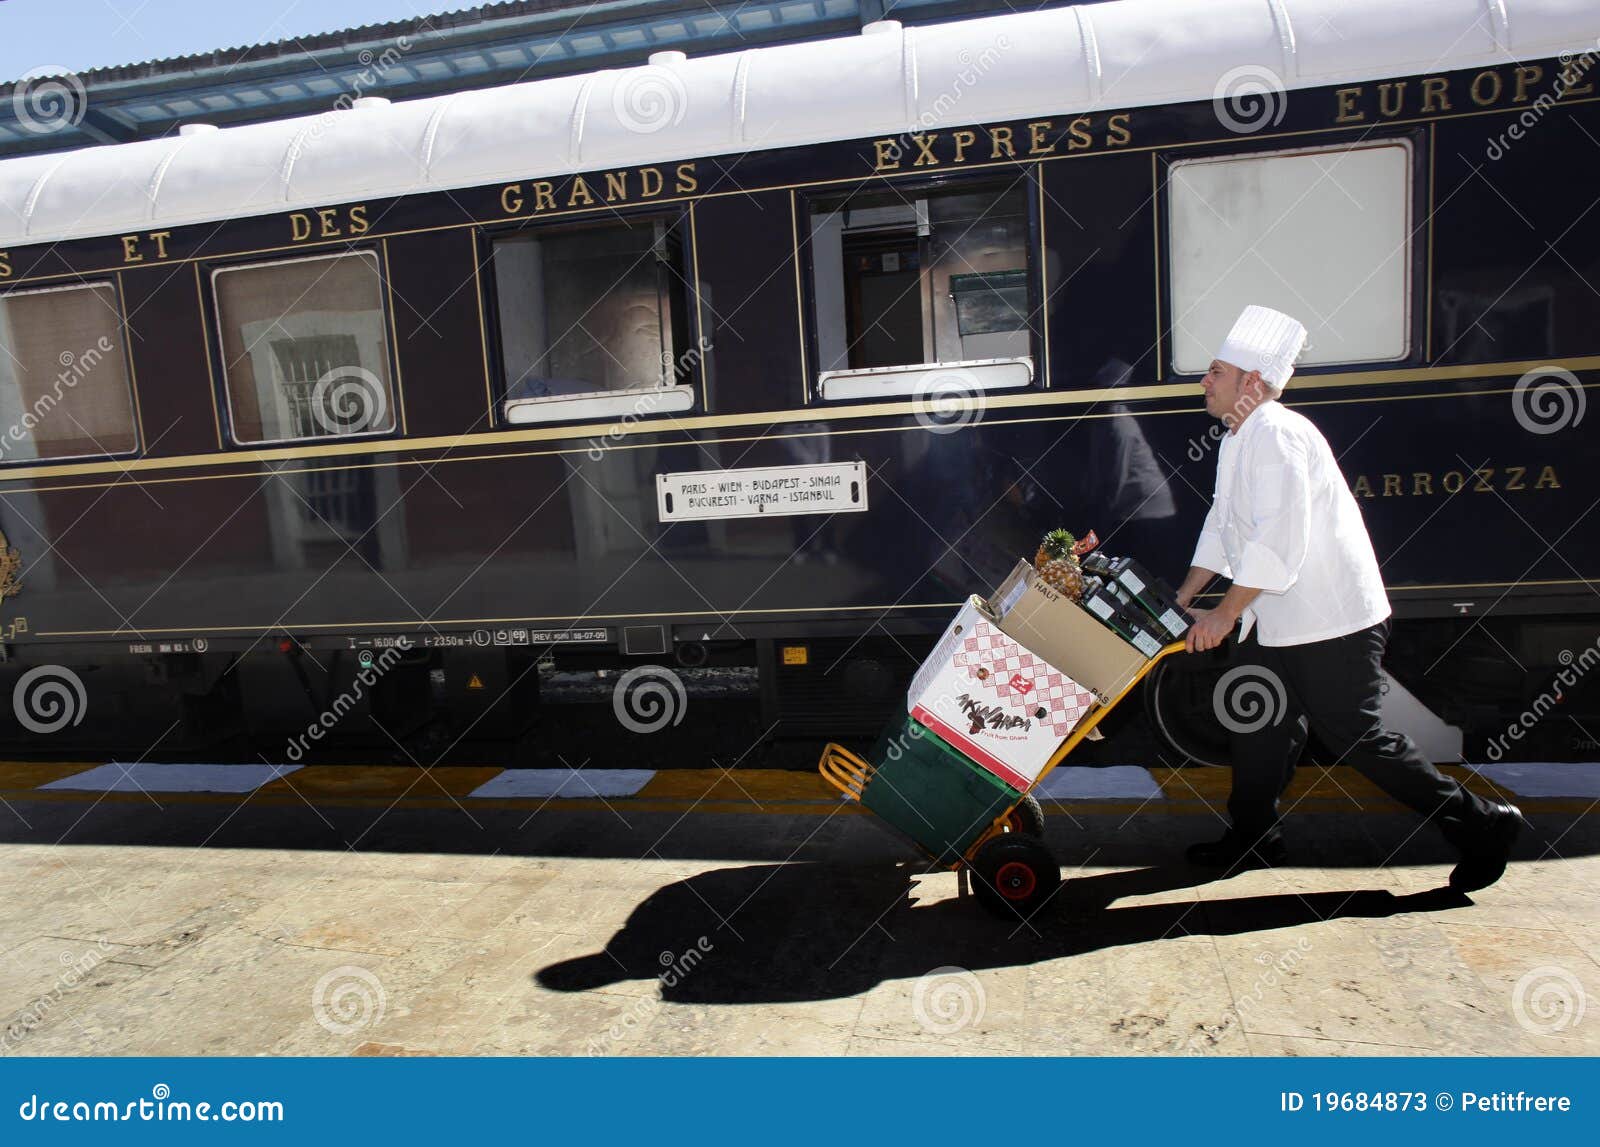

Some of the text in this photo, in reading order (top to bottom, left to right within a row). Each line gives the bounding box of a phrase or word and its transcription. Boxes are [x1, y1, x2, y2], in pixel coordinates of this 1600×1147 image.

[121, 231, 170, 263] ET
[291, 205, 370, 241] DES
[501, 163, 698, 213] GRANDS
[873, 113, 1130, 171] EXPRESS
[681, 483, 707, 495] PARIS
[718, 481, 742, 493] WIEN
[752, 478, 800, 491] BUDAPEST
[809, 475, 841, 487] SINAIA
[688, 494, 737, 508] BUCURESTI
[747, 491, 779, 504] VARNA
[789, 490, 835, 502] ISTANBUL
[1034, 582, 1059, 602] HAUT
